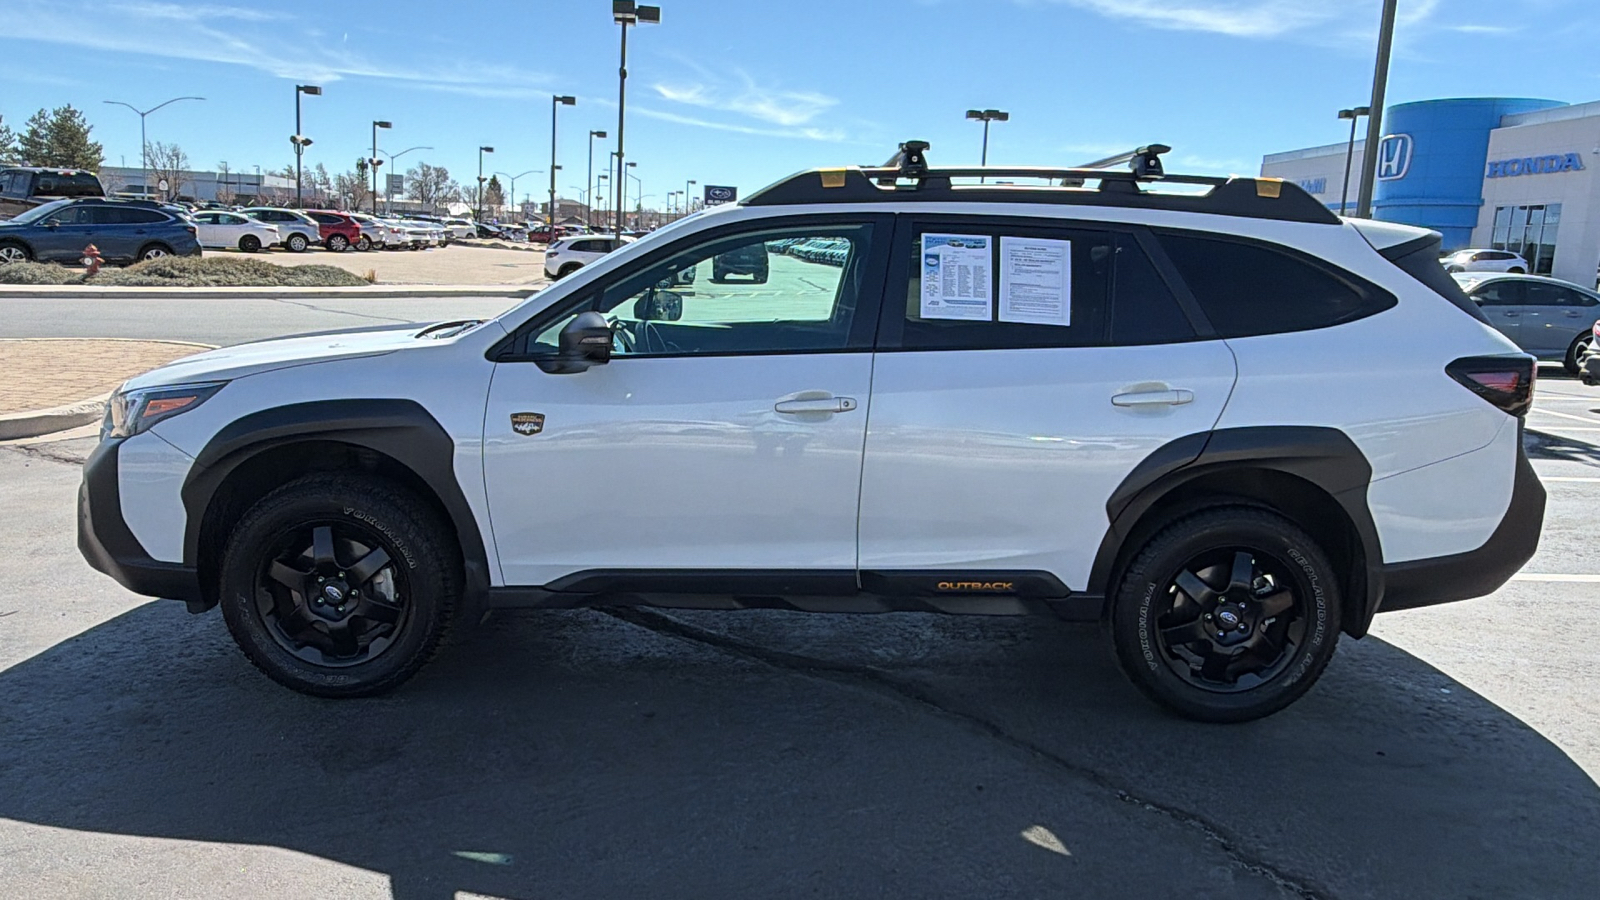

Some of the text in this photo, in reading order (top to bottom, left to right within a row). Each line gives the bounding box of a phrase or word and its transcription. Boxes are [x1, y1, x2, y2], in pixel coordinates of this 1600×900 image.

[1486, 153, 1585, 178] HONDA
[343, 506, 417, 570] YOKOHAMA
[937, 581, 1013, 590] OUTBACK
[1287, 548, 1326, 646] GEOLANDAR
[1138, 582, 1158, 671] YOKOHAMA
